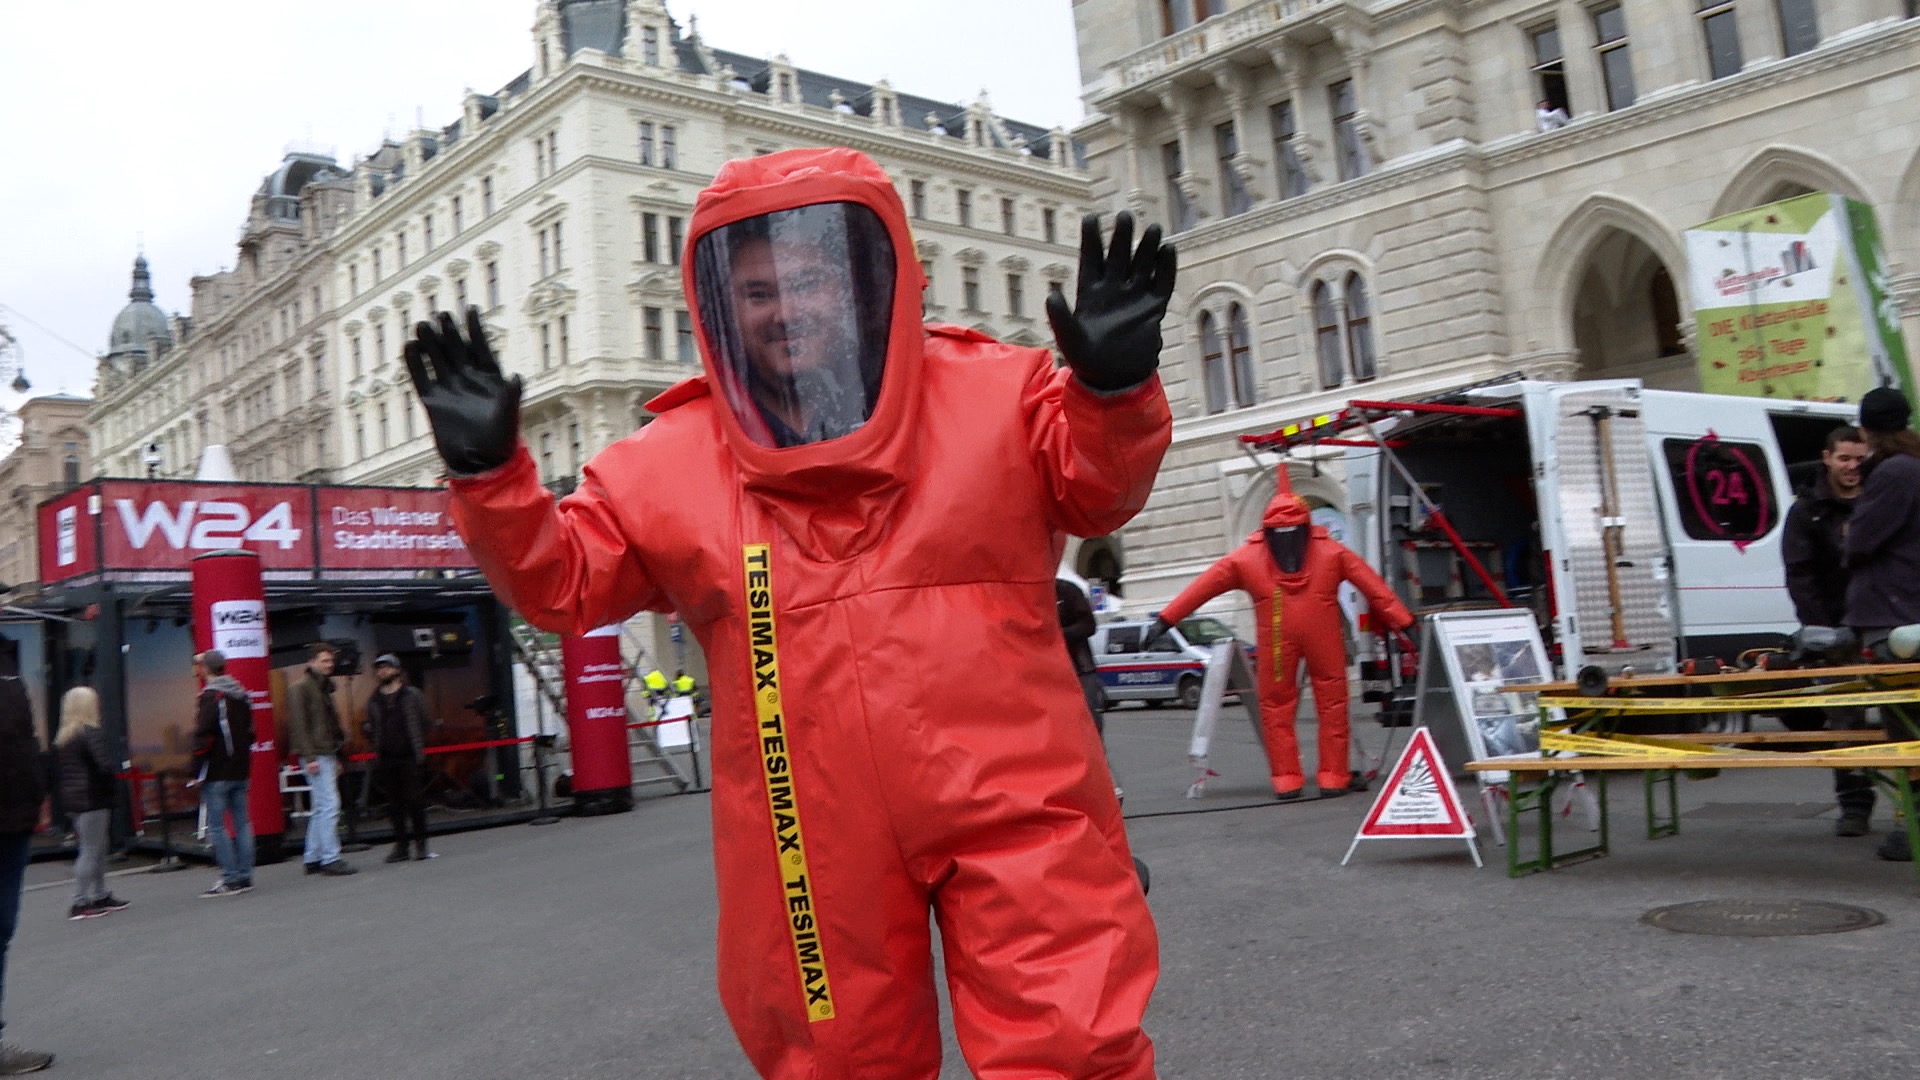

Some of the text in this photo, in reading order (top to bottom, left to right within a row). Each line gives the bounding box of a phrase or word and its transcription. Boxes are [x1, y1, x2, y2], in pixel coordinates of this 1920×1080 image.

[1708, 318, 1736, 337] DIE
[1705, 469, 1748, 505] 24
[114, 499, 303, 549] W24
[332, 506, 443, 526] Das Wiener
[333, 529, 466, 549] Stadtfernseh
[748, 549, 829, 1006] TESIMAX TESIMAX TESIMAX
